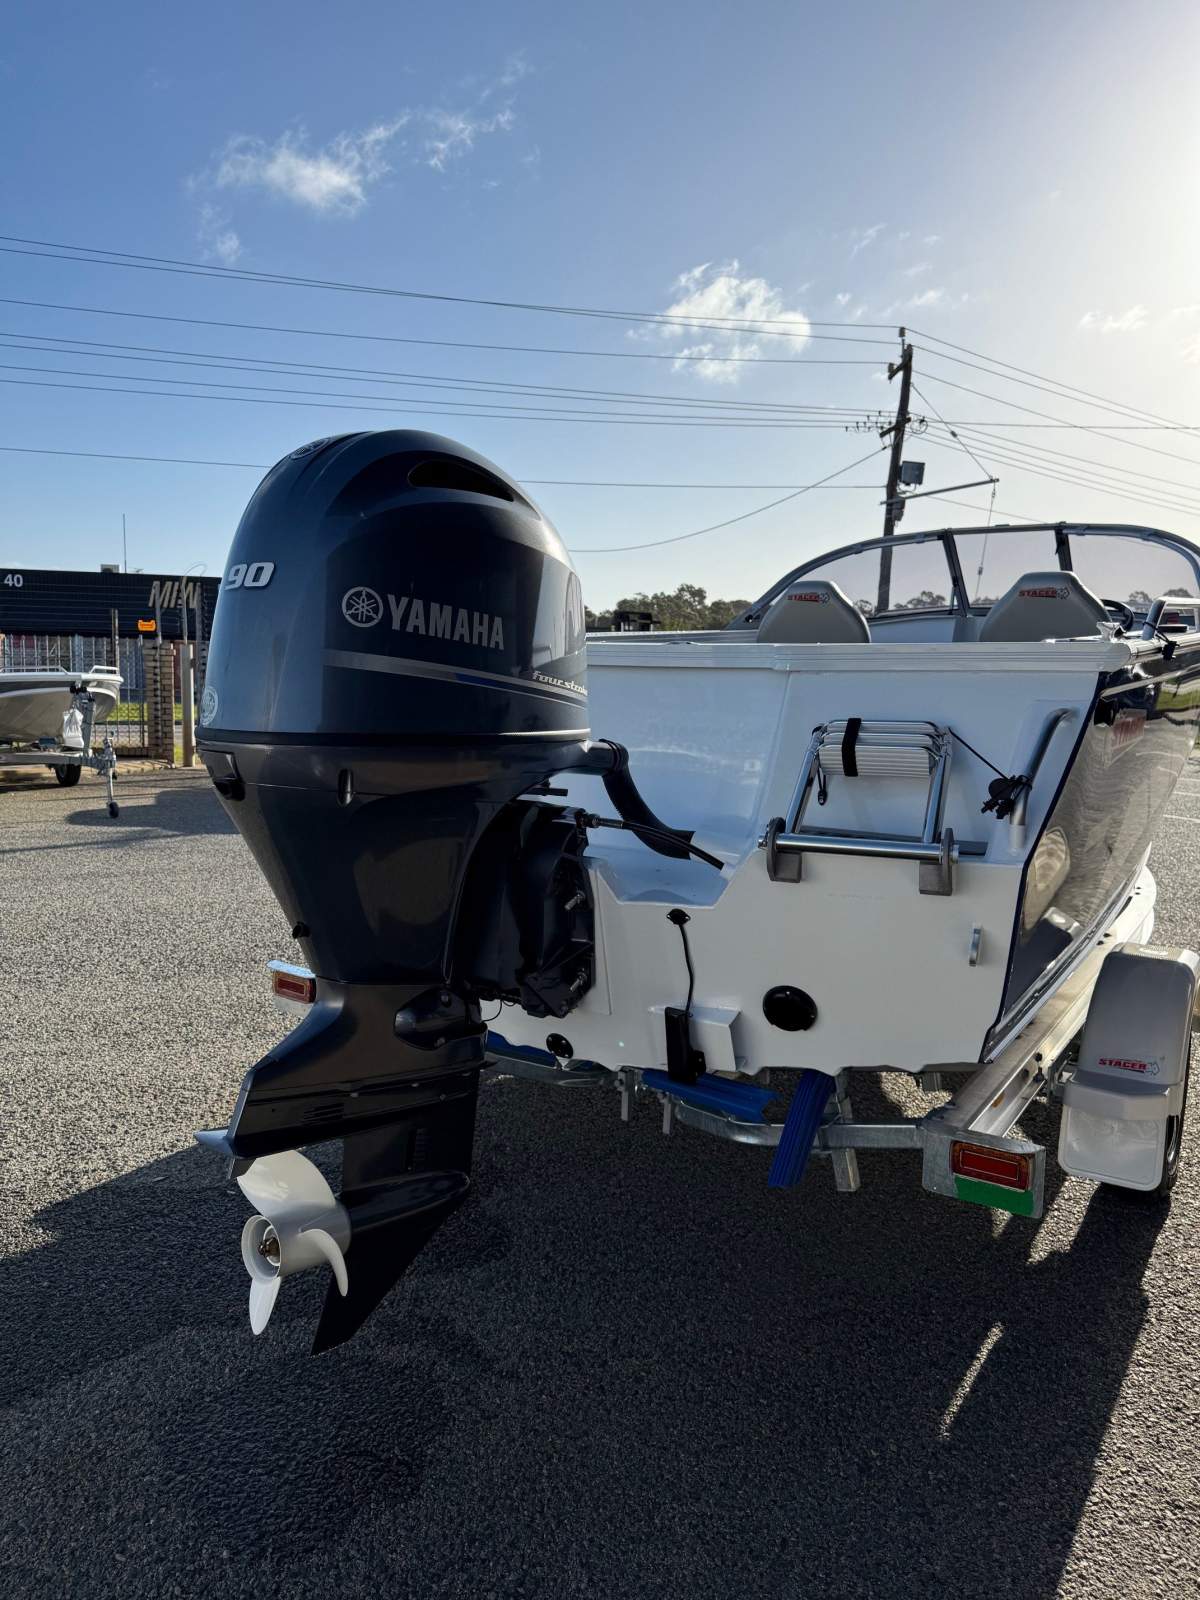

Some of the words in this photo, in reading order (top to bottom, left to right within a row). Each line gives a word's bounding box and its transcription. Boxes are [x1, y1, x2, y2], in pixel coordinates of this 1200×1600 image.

[4, 573, 24, 588] 40
[223, 561, 275, 591] 90
[387, 594, 505, 650] YAMAHA
[1098, 1057, 1147, 1072] STACER
